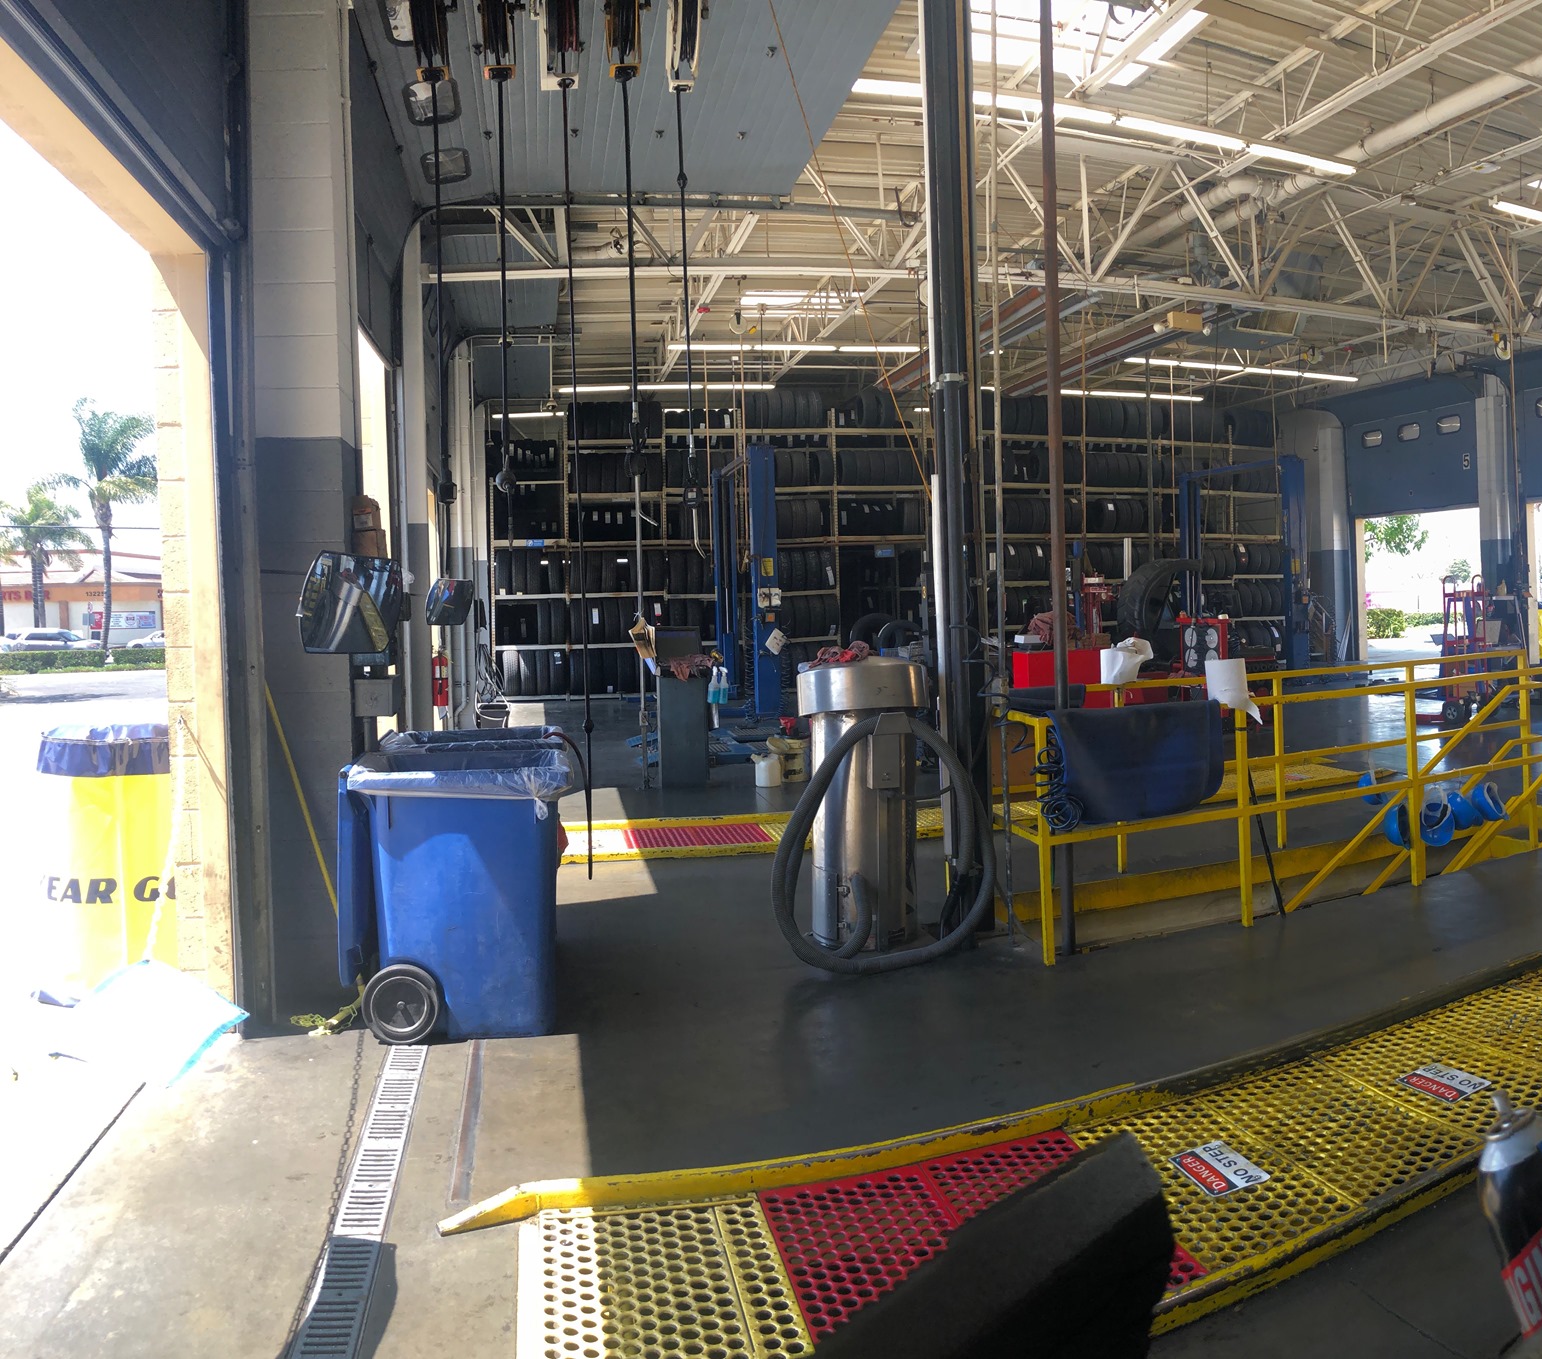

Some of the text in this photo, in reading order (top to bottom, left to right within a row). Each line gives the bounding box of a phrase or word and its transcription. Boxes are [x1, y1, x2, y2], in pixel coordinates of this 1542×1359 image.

[1463, 454, 1470, 468] 5
[24, 590, 50, 600] BR
[46, 876, 117, 904] EAR
[1409, 1076, 1457, 1098] DANGER
[1422, 1065, 1481, 1090] NO STEP
[1182, 1156, 1226, 1190] DANGER
[1203, 1144, 1261, 1183] NO STEP
